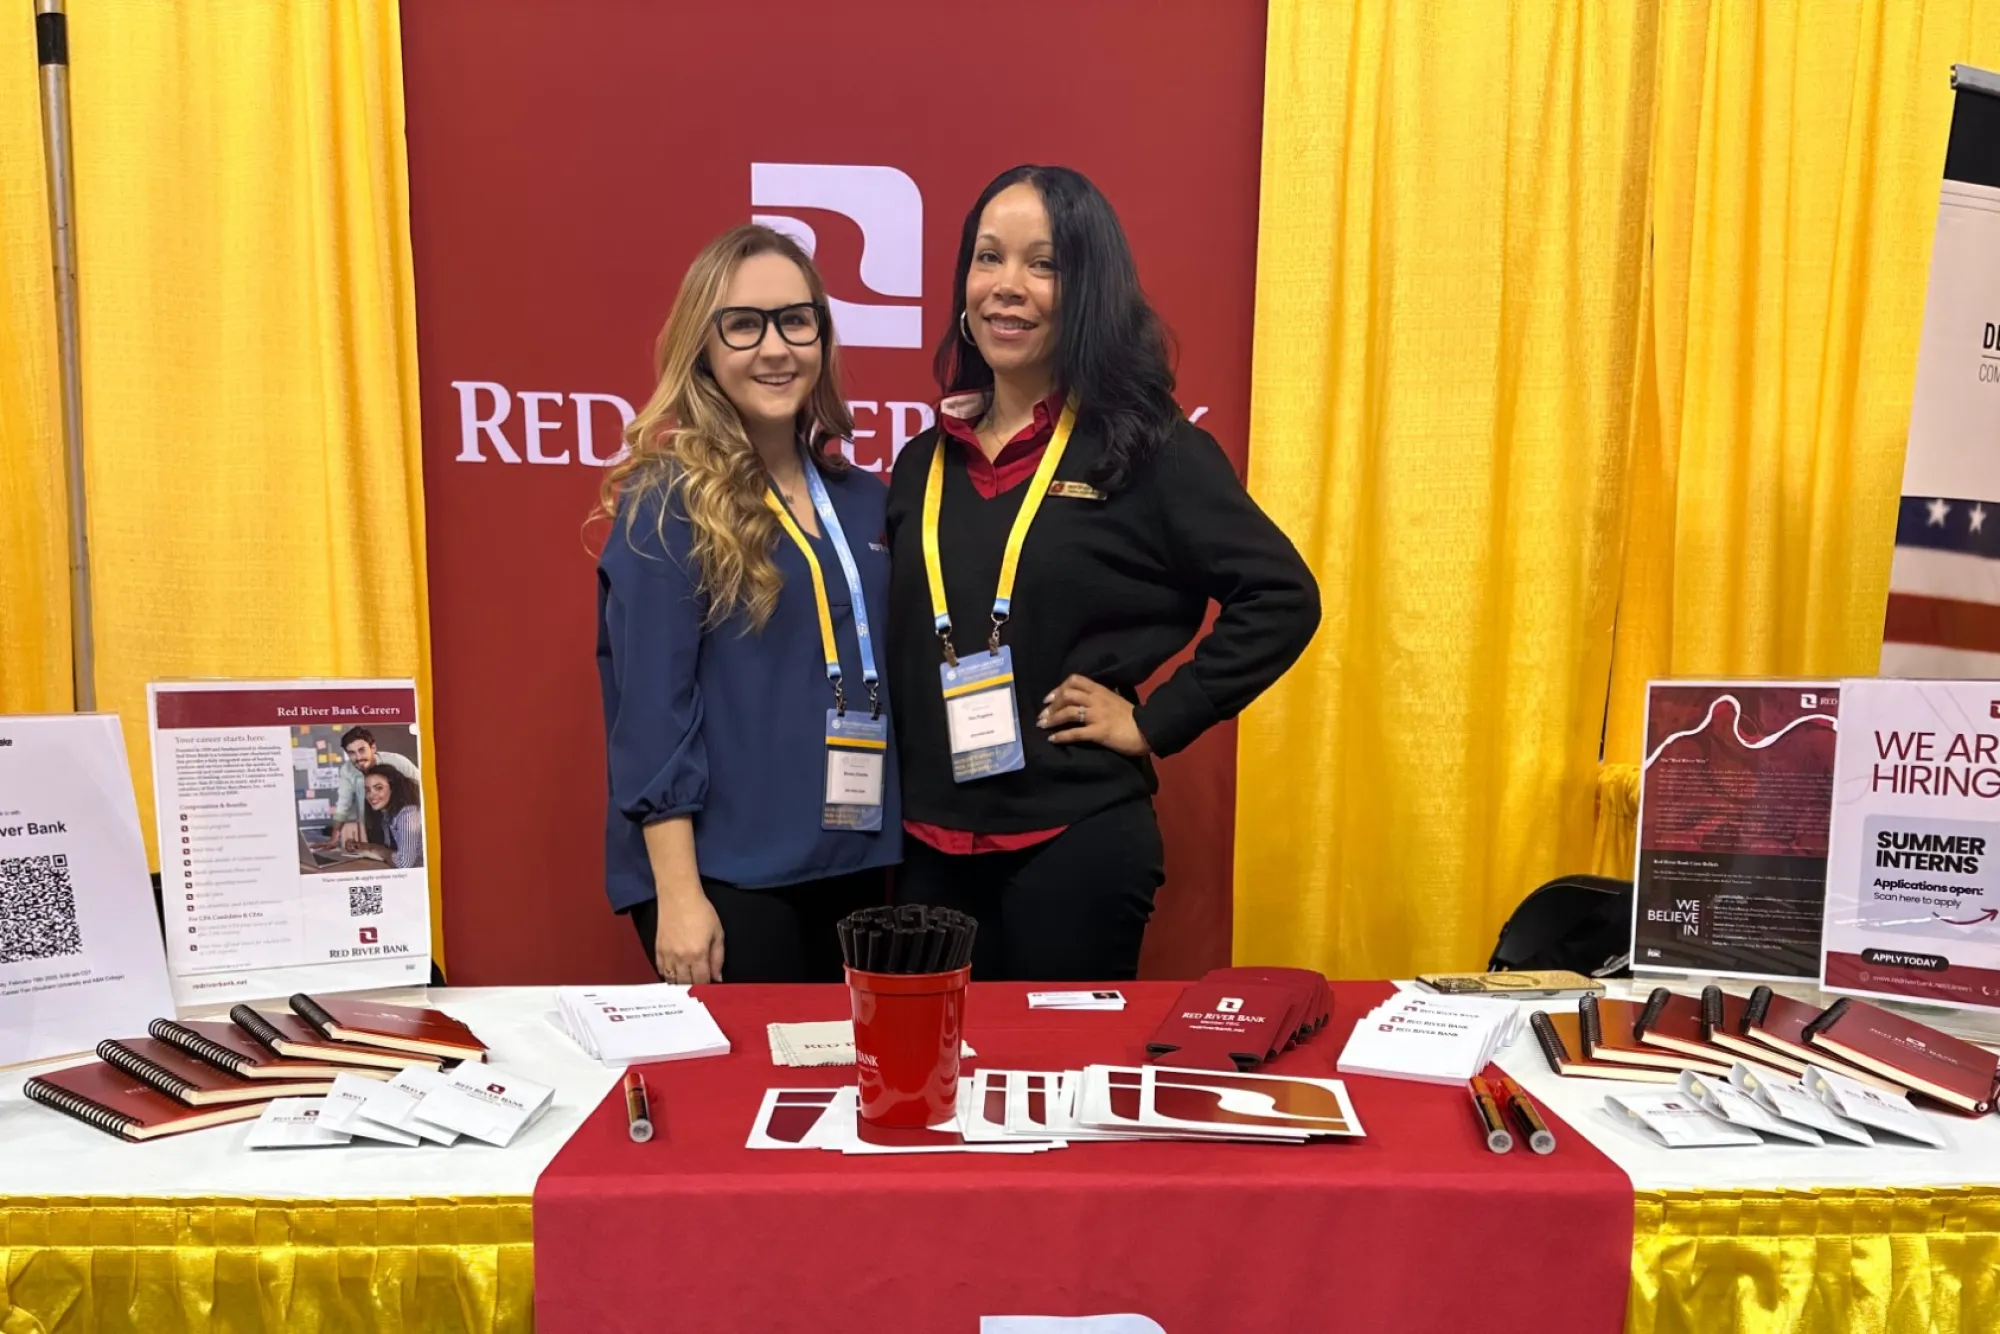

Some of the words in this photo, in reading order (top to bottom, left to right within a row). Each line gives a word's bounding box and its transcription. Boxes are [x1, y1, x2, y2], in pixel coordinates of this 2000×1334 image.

[451, 381, 637, 467] RED
[277, 706, 298, 717] Red
[300, 706, 329, 716] River
[332, 705, 359, 716] Bank
[361, 705, 401, 715] Careers
[175, 736, 194, 744] Your
[223, 735, 245, 743] starts
[1874, 730, 1936, 761] WE
[1872, 763, 2000, 798] HIRING
[27, 821, 67, 836] Bank
[1877, 831, 1986, 855] SUMMER
[1876, 849, 1979, 875] INTERNS
[1873, 878, 1949, 893] Applications
[1949, 886, 1984, 896] open:
[1676, 899, 1700, 912] WE
[1873, 892, 1898, 901] Scan
[1899, 893, 1921, 904] here
[1922, 895, 1932, 904] to
[1933, 897, 1962, 910] apply
[1648, 910, 1700, 924] BELIEVE
[1683, 924, 1699, 937] IN
[329, 949, 349, 958] RED
[351, 947, 381, 957] RIVER
[383, 944, 409, 954] BANK
[1872, 953, 1902, 965] APPLY
[1903, 956, 1938, 968] TODAY
[1204, 1012, 1235, 1021] RIVER
[1237, 1014, 1267, 1023] BANK
